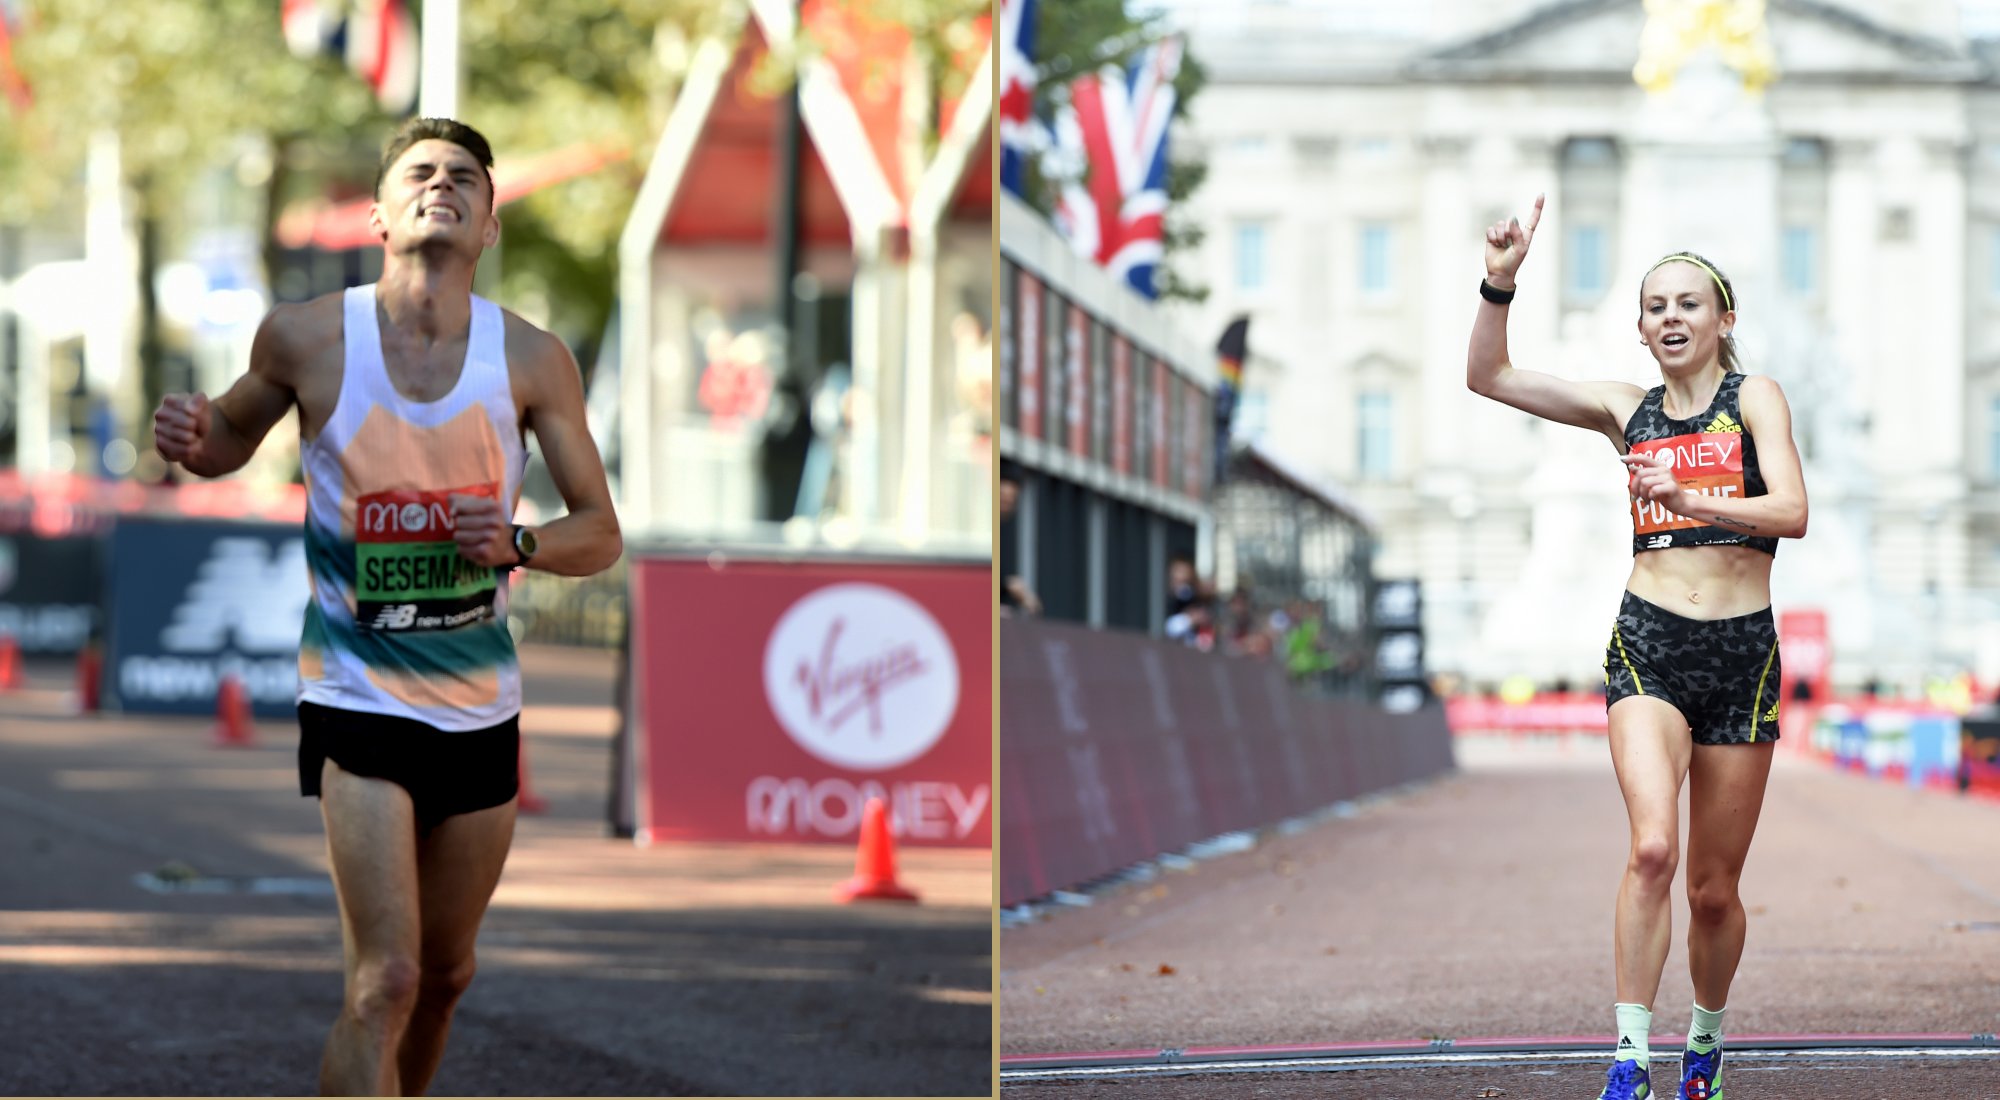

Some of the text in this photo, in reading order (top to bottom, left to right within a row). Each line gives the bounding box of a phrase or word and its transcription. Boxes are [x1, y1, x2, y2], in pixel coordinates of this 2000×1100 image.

[365, 503, 455, 532] MON
[417, 617, 441, 628] new
[445, 606, 486, 625] balance
[793, 614, 929, 736] Virgin
